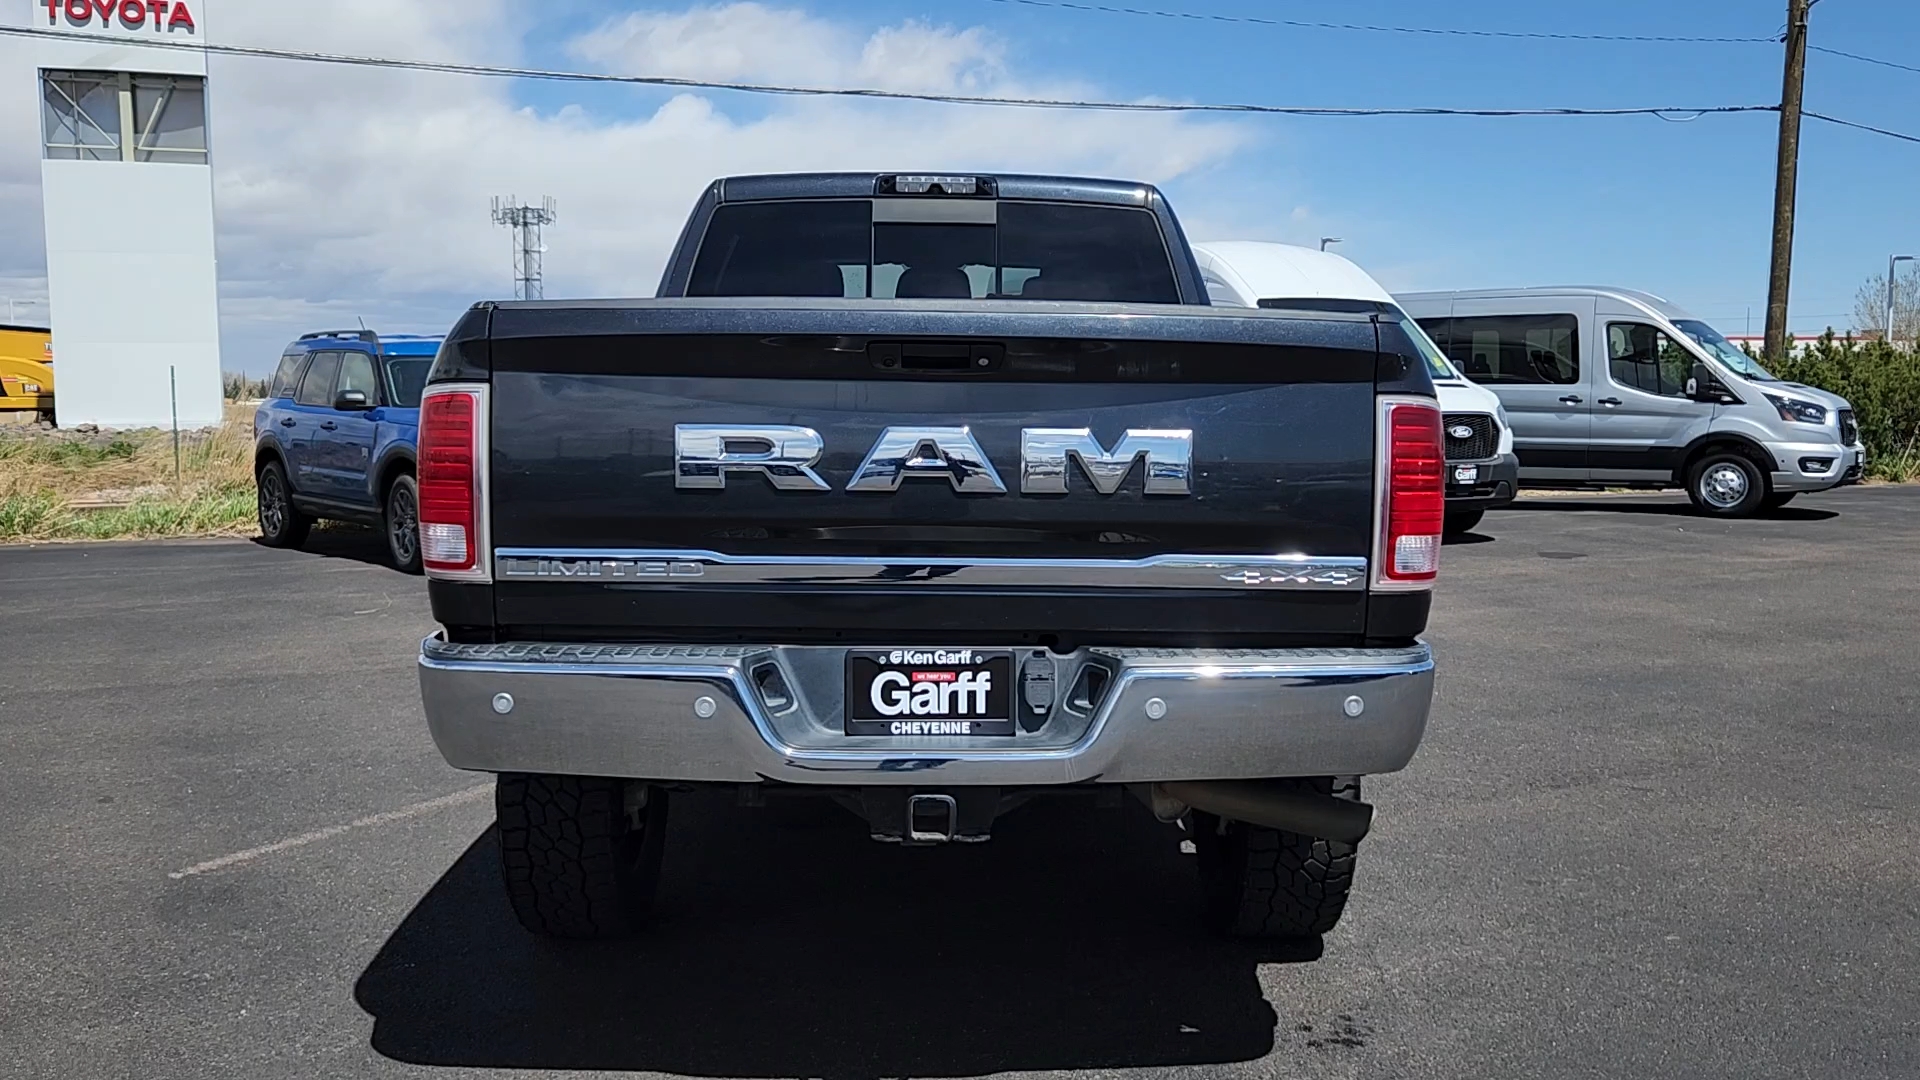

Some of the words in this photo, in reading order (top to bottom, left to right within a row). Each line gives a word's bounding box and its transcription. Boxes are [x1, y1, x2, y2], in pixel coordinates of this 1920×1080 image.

[44, 0, 195, 29] TOYOTA
[675, 423, 1193, 494] RAM
[1455, 468, 1477, 480] Garff
[506, 559, 704, 577] LIMITED
[904, 651, 933, 665] Ken
[934, 650, 972, 665] Garff
[871, 671, 991, 716] Garff
[891, 722, 971, 734] CHEYENNE
